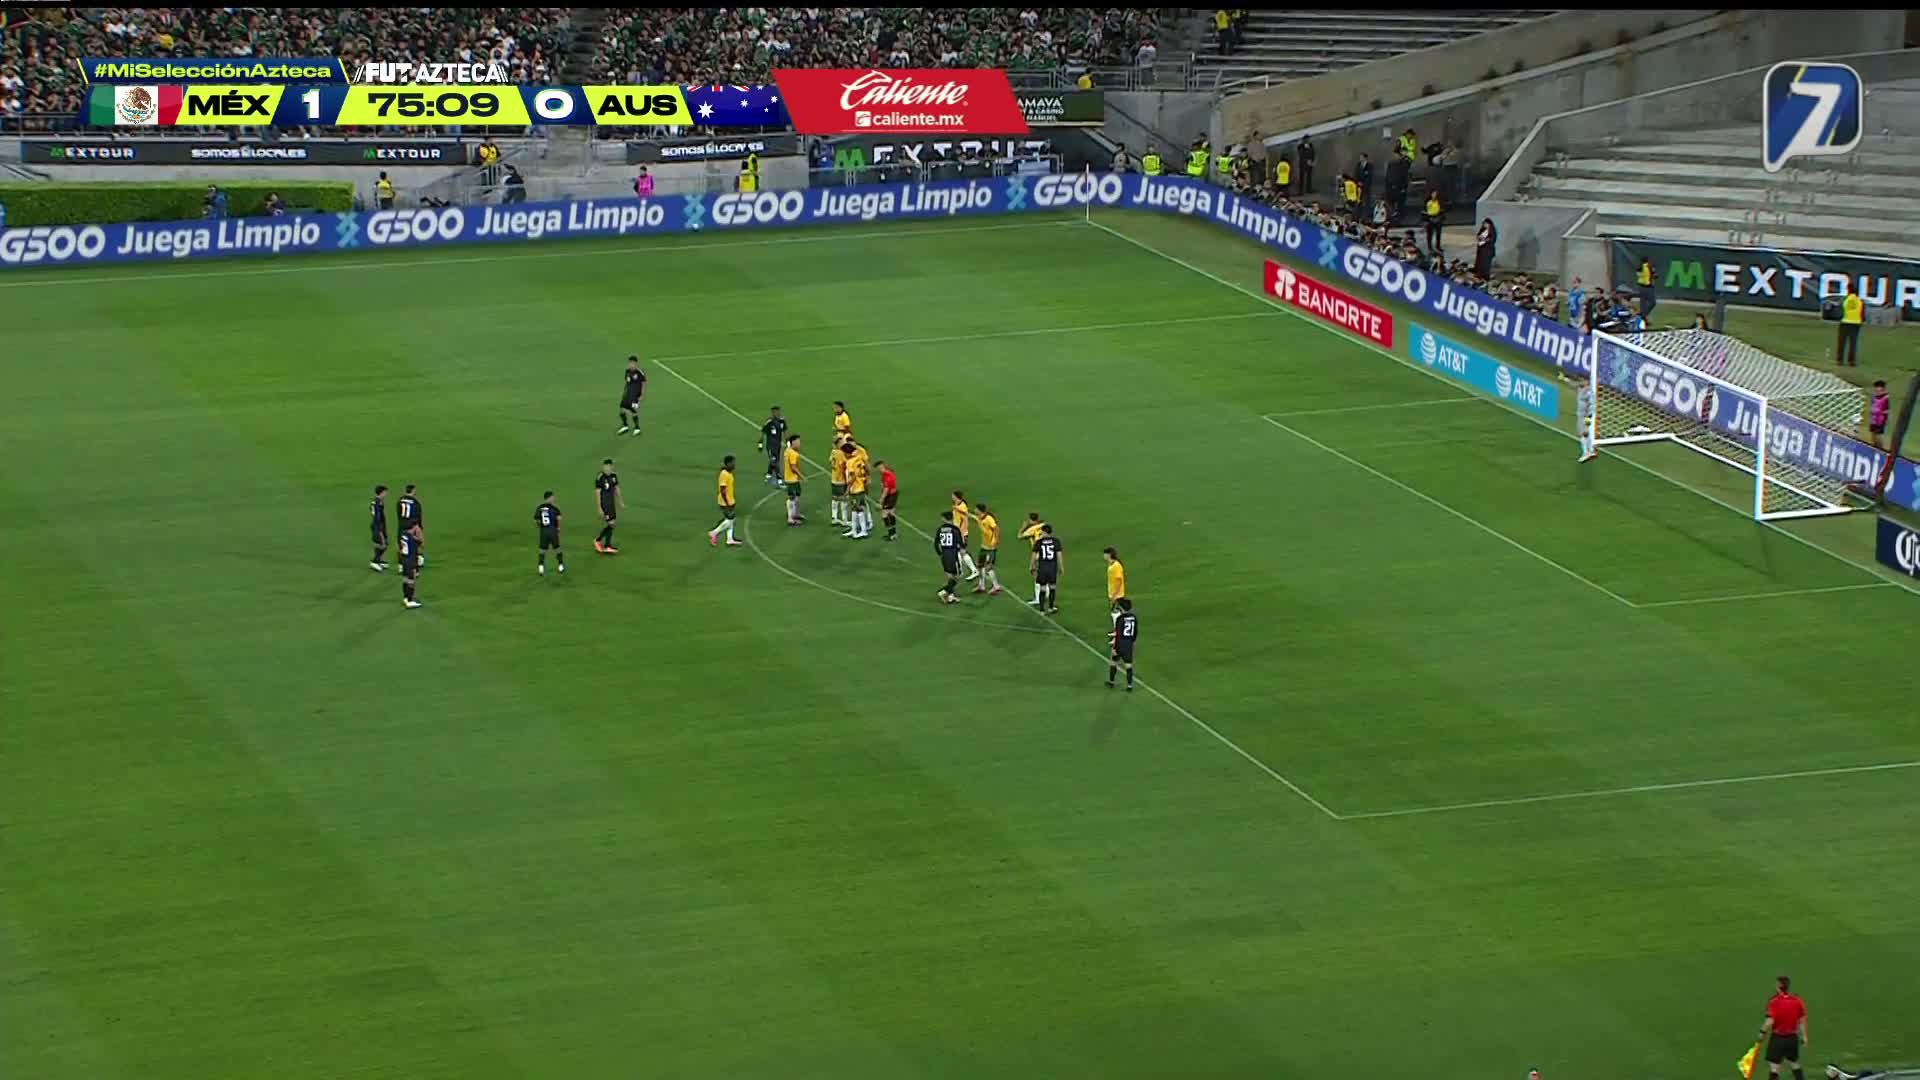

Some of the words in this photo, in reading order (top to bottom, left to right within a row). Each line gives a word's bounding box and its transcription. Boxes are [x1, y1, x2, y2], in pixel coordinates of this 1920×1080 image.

[49, 146, 134, 158] MEXTOUR
[362, 147, 441, 158] MEXTOUR
[711, 191, 804, 225] G500
[813, 187, 894, 218] Juega
[902, 182, 992, 213] Limpio
[1034, 174, 1122, 206] G500
[1132, 177, 1212, 215] Juega
[1216, 192, 1302, 249] Limpio
[0, 226, 106, 263] G500
[117, 225, 210, 258] Juega
[217, 215, 321, 253] Limpio
[366, 208, 465, 244] G500
[475, 205, 564, 239] Juega
[569, 201, 664, 232] Limpio
[1343, 245, 1427, 302] G500
[1433, 284, 1508, 337] Juega
[1664, 259, 1920, 309] MEXTOUR
[1298, 283, 1382, 340] BANORTE
[1438, 345, 1469, 376] AT&T
[1512, 376, 1544, 407] AT&T
[940, 532, 953, 547] 28
[1041, 545, 1055, 560] 15
[1123, 620, 1135, 637] 21
